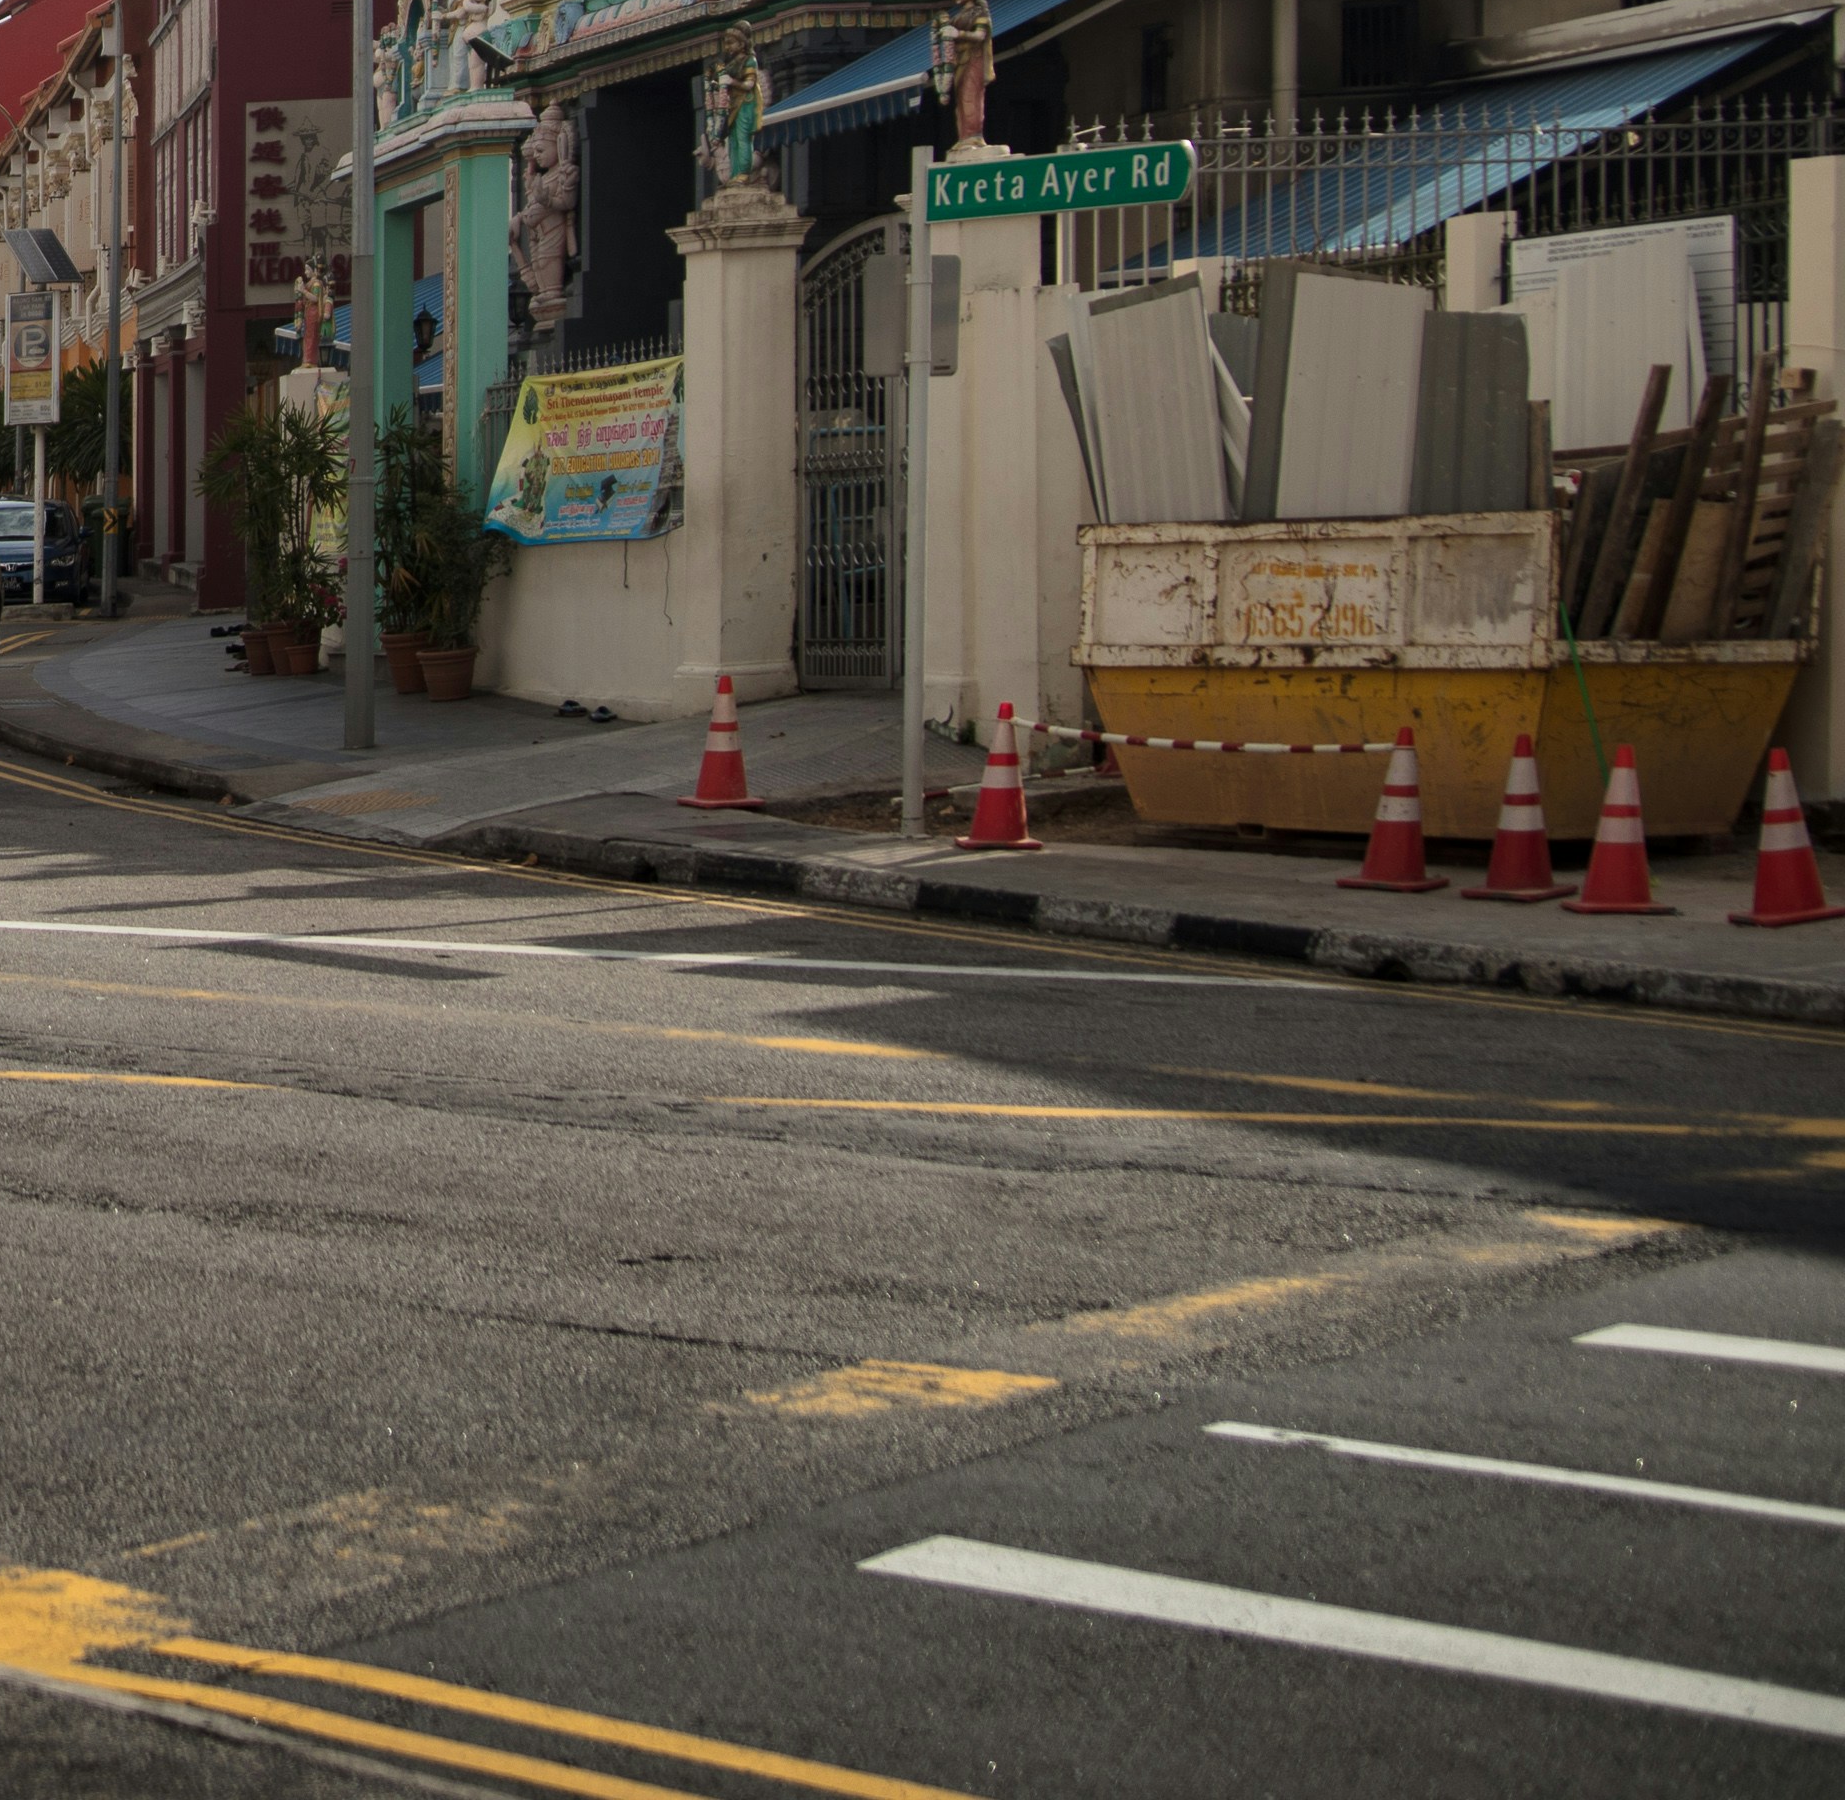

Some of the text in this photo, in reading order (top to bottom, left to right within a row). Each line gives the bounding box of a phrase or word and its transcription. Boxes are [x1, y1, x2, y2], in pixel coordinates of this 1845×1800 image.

[934, 151, 1171, 208] Kreta Ayer Rd
[250, 242, 281, 256] THE
[249, 256, 309, 286] KEON
[21, 328, 46, 358] P
[547, 398, 559, 409] Sri
[633, 383, 665, 397] Temple
[566, 452, 607, 475] EDUCATION
[608, 449, 640, 471] AWARDS
